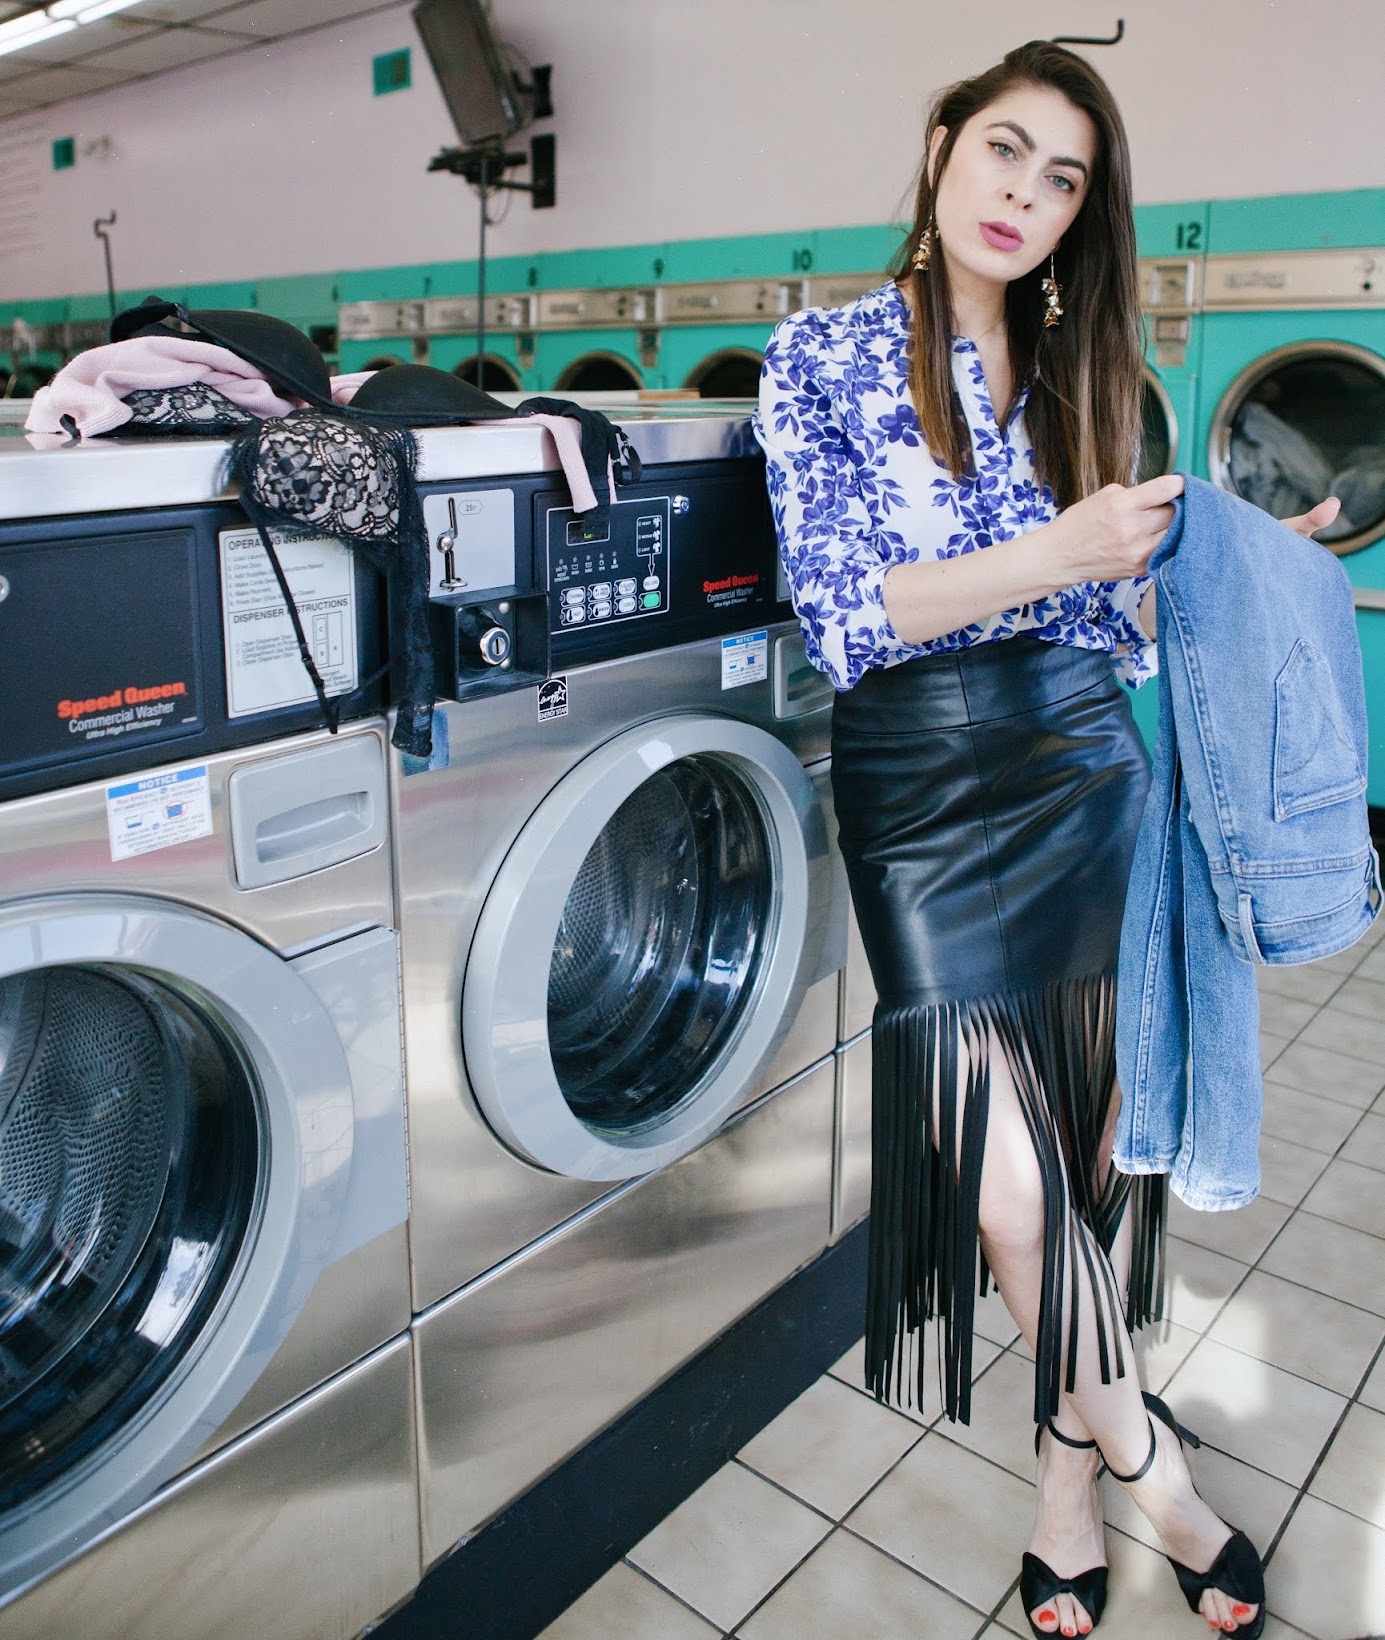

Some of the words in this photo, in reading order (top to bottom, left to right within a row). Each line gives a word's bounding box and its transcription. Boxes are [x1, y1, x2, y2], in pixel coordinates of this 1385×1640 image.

[1176, 221, 1202, 250] 12
[792, 248, 812, 272] 10
[228, 536, 280, 550] OPERAG
[702, 576, 732, 594] Speed
[732, 574, 759, 586] Queen
[706, 588, 736, 603] Commercial
[736, 587, 754, 598] Washer
[233, 608, 284, 624] DISPENSER
[287, 598, 348, 614] STRUCTIONS
[736, 635, 754, 645] NOTICE
[58, 690, 122, 719] Speed
[124, 681, 186, 705] Queen
[68, 708, 134, 734] Commercial
[135, 701, 175, 720] Washer
[86, 728, 105, 740] Ultra
[106, 724, 125, 736] High
[125, 718, 162, 732] Efficiency
[138, 774, 179, 791] NOTICE
